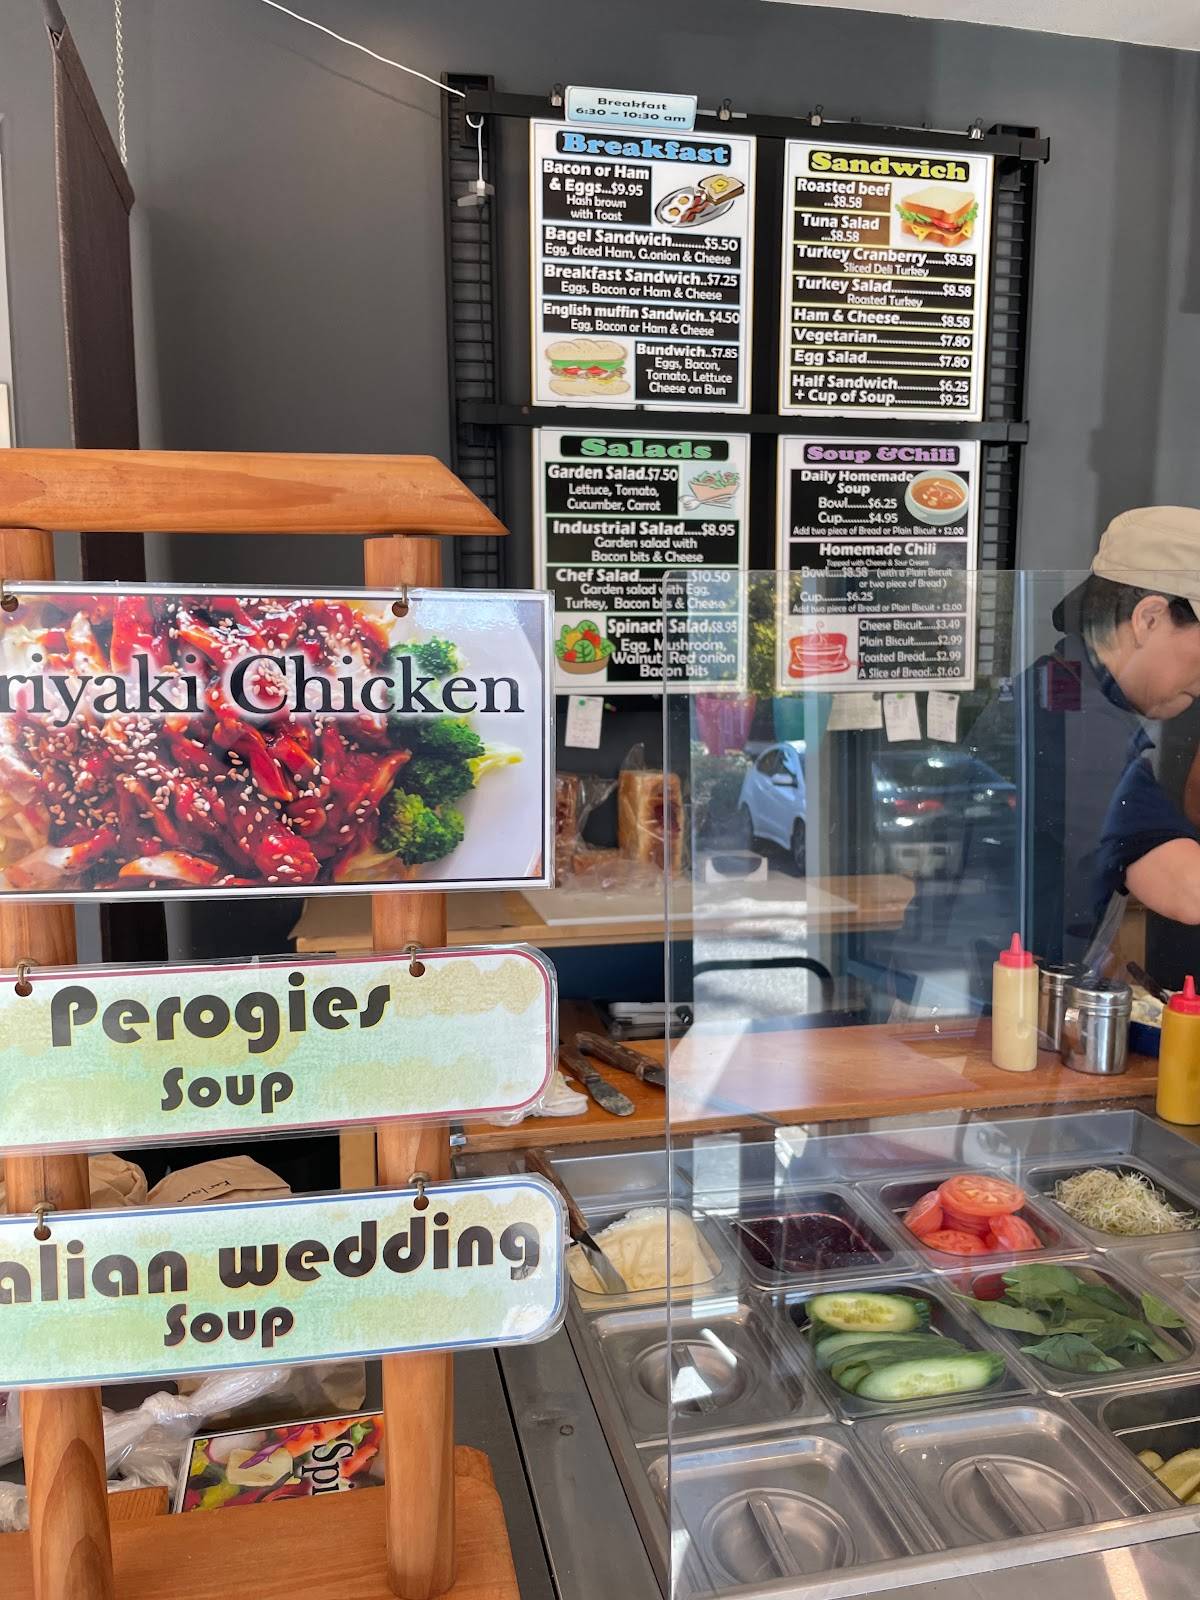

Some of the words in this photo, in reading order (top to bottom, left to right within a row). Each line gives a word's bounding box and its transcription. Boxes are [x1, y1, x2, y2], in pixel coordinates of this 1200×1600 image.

[598, 98, 666, 110] Breakfast
[576, 107, 606, 116] 6:30
[623, 111, 659, 120] 10:30
[563, 133, 728, 164] Breakfast
[543, 160, 591, 176] Bacon
[595, 166, 611, 177] or
[615, 166, 649, 179] Ham
[812, 152, 966, 180] Sandwich
[549, 179, 561, 190] &
[797, 178, 855, 193] Roasted
[859, 183, 890, 196] beef
[567, 195, 592, 207] Hash
[595, 196, 626, 208] brown
[571, 209, 592, 219] with
[596, 210, 622, 221] Toast
[801, 214, 838, 227] Tuna
[841, 216, 880, 230] Salad
[545, 228, 591, 245] Bagel
[545, 243, 569, 257] Egg,
[573, 245, 602, 256] diced
[605, 247, 636, 259] Ham,
[682, 253, 692, 262] &
[694, 254, 731, 264] Cheese
[797, 245, 849, 262] Turkey
[544, 264, 621, 281] Breakfast
[844, 263, 871, 273] Sliced
[874, 265, 893, 274] Deli
[896, 265, 929, 277] Turkey
[561, 281, 589, 294] Eggs,
[592, 283, 626, 295] Bacon
[629, 287, 639, 296] or
[643, 285, 671, 297] Ham
[674, 288, 683, 298] &
[685, 288, 722, 300] Cheese
[796, 277, 848, 294] Turkey
[848, 294, 886, 305] Roasted
[889, 296, 923, 308] Turkey
[543, 303, 591, 318] English
[595, 306, 639, 318] muffin
[794, 309, 829, 321] Ham
[832, 310, 843, 322] &
[571, 319, 593, 331] Egg,
[596, 320, 627, 331] Bacon
[629, 323, 639, 332] or
[642, 322, 667, 334] Ham
[670, 325, 678, 334] &
[681, 324, 714, 335] Cheese
[655, 358, 682, 370] Eggs,
[685, 359, 720, 371] Bacon,
[795, 350, 823, 365] Egg
[646, 370, 690, 382] Tomato,
[693, 371, 732, 383] Lettuce
[793, 375, 824, 388] Half
[649, 382, 686, 393] Cheese
[688, 385, 702, 394] on
[704, 384, 726, 395] Bun
[808, 389, 837, 404] Cup
[841, 390, 856, 401] of
[580, 439, 712, 459] Salads
[807, 446, 871, 463] Soup
[548, 465, 603, 479] Garden
[801, 471, 836, 484] Daily
[839, 471, 914, 482] Homemade
[569, 484, 612, 496] Lettuce,
[615, 484, 659, 497] Tomato,
[837, 483, 870, 496] Soup
[567, 499, 625, 511] Cucumber,
[627, 500, 661, 511] Carrot
[553, 521, 635, 535] Industrial
[594, 537, 638, 548] Garden
[640, 538, 671, 549] salad
[673, 538, 697, 549] with
[820, 544, 901, 556] Homemade
[905, 544, 936, 556] Chili
[592, 551, 628, 562] Bacon
[630, 551, 650, 562] bits
[652, 552, 662, 562] &
[664, 552, 704, 562] Cheese
[556, 569, 594, 582] Chef
[580, 584, 624, 595] Garden
[626, 584, 656, 595] salad
[565, 598, 608, 610] Turkey,
[614, 598, 650, 609] Bacon
[675, 599, 684, 609] &
[608, 620, 664, 637] Spinach
[860, 621, 891, 630] Cheese
[621, 639, 650, 653] Egg,
[654, 639, 727, 651] Mushroom,
[860, 637, 883, 647] Plain
[671, 653, 695, 664] Red
[701, 654, 735, 663] onion
[859, 653, 896, 662] Toasted
[640, 666, 683, 677] Bacon
[686, 666, 708, 676] bits
[859, 669, 865, 678] A
[869, 668, 888, 678] Slice
[891, 668, 900, 677] of
[0, 653, 203, 727] riyaki
[230, 655, 524, 714] Chicken
[51, 971, 391, 1053] Perogies
[161, 1067, 294, 1113] Soup
[0, 1239, 187, 1303] alian
[219, 1212, 541, 1280] wedding
[163, 1303, 294, 1348] Soup
